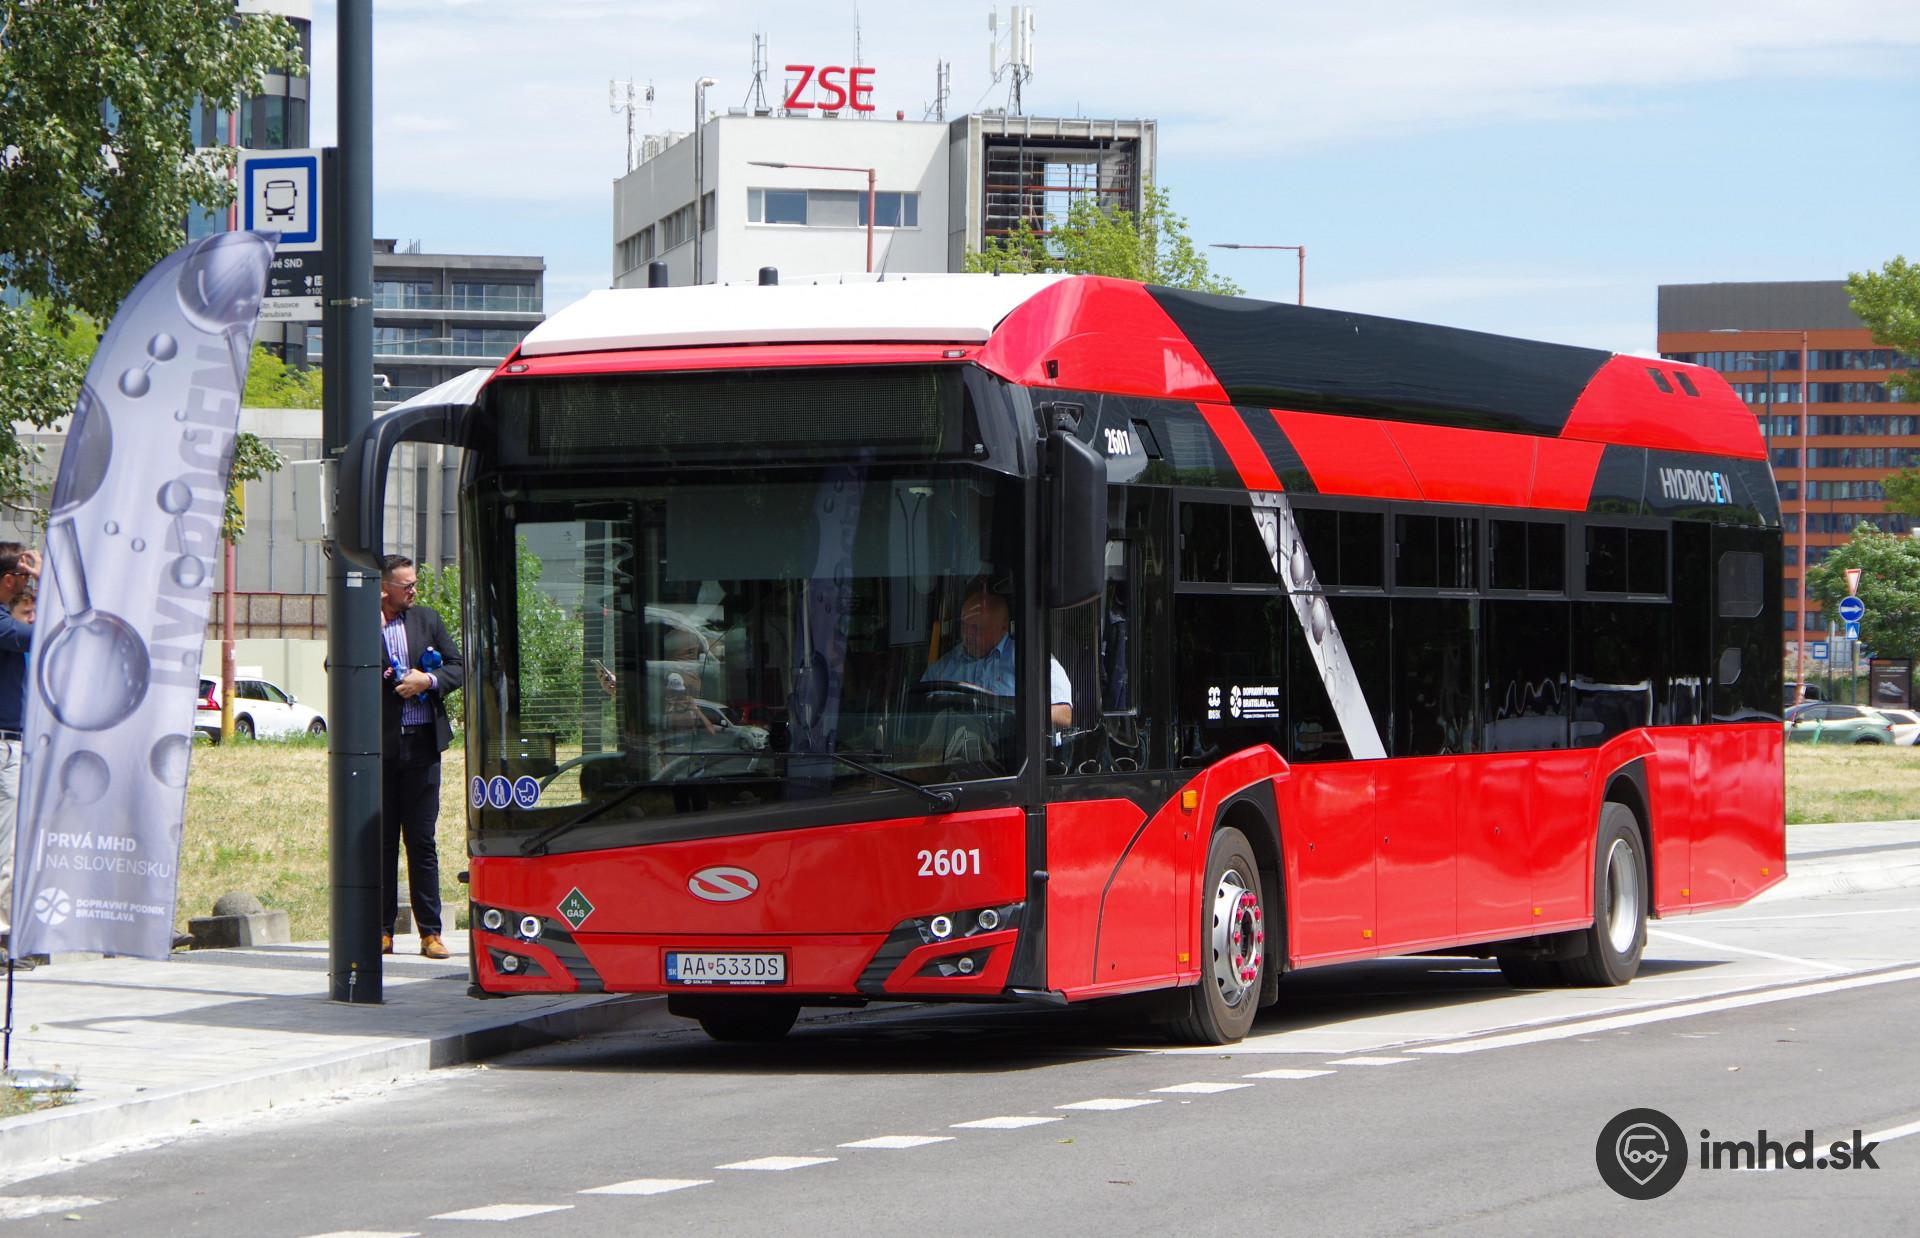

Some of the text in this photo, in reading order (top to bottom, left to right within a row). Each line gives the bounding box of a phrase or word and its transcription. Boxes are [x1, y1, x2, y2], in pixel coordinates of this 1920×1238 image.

[784, 64, 876, 111] ZSE
[284, 258, 303, 268] SND
[1104, 427, 1132, 456] 2601
[1660, 467, 1733, 505] HYDROGEN
[47, 832, 137, 853] PRVÁ MHD
[45, 854, 170, 878] NA SLOVENSKU
[917, 848, 981, 877] 2601
[75, 909, 135, 923] BRATISLAVA
[566, 909, 585, 918] GAS
[668, 968, 677, 976] SK
